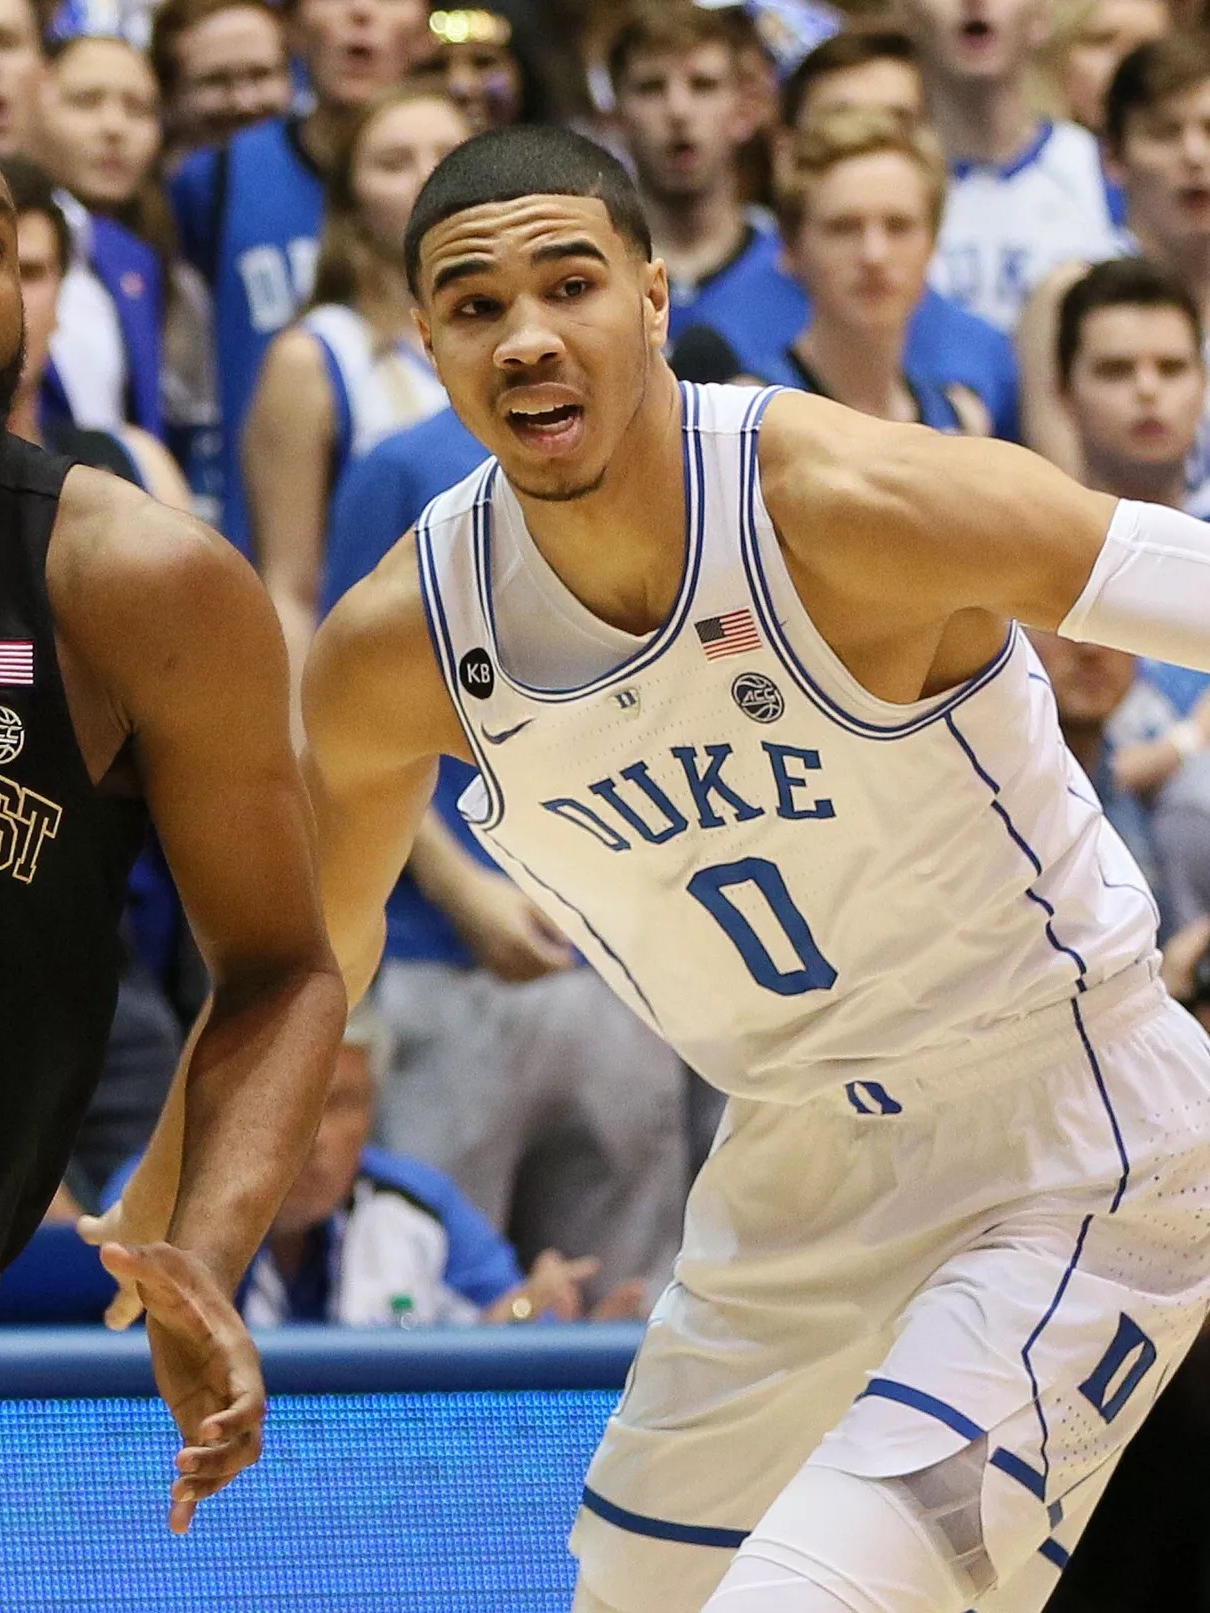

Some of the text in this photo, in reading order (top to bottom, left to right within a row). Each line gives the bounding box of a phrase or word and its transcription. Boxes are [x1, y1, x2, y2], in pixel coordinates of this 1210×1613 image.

[466, 663, 491, 684] KB
[541, 740, 836, 852] DUKE
[686, 856, 839, 997] 0
